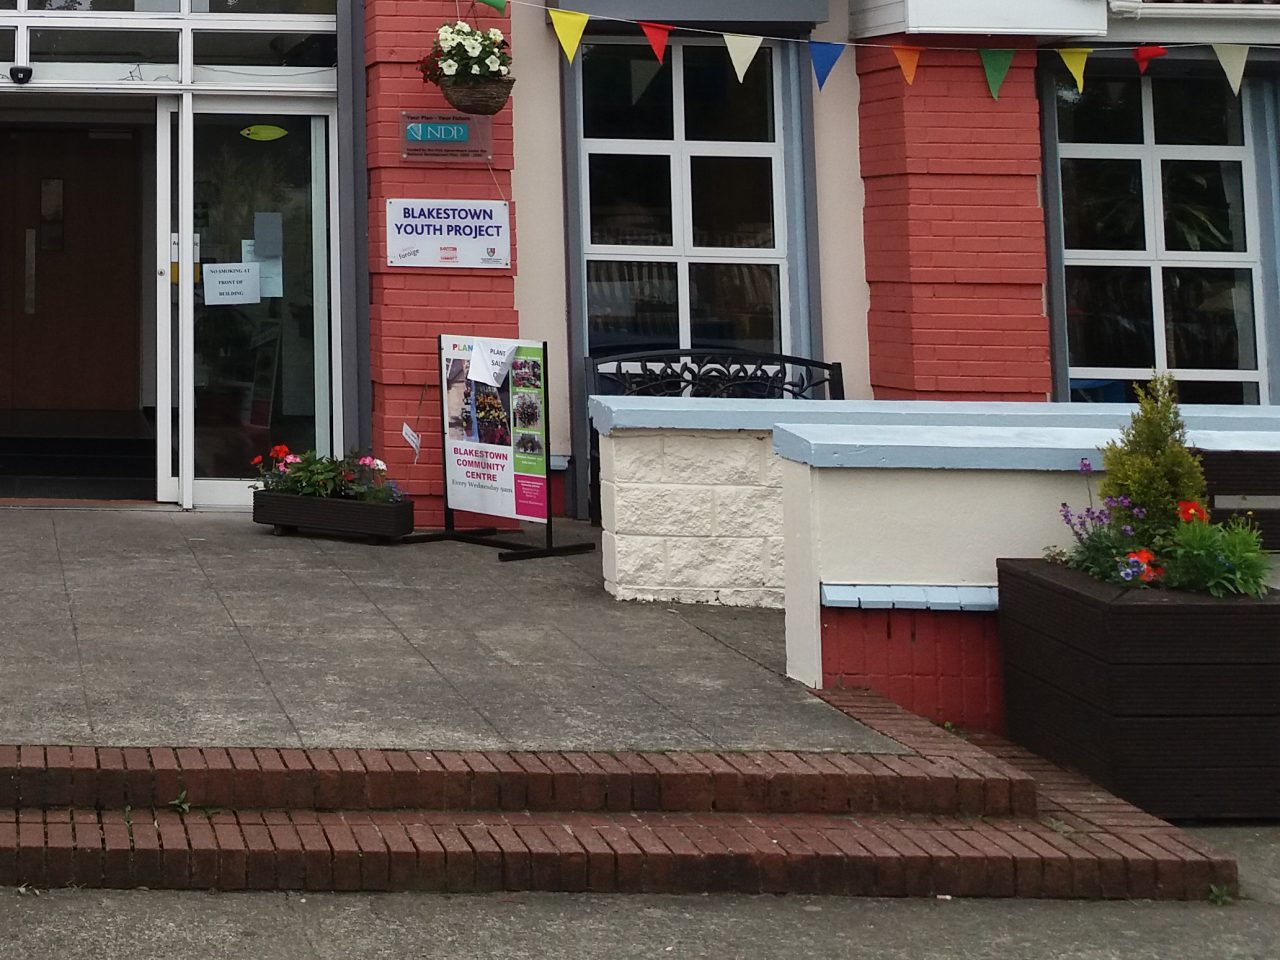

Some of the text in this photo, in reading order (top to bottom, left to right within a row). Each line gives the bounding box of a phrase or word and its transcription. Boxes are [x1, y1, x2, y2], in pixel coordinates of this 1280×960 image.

[427, 125, 464, 139] NDP
[403, 207, 493, 220] BLAKESTOWN
[395, 224, 502, 239] YOUTH PROJECT
[489, 348, 506, 357] PLANT
[453, 447, 508, 461] BLAKESTOWN
[456, 458, 506, 472] COMMUNITY
[465, 471, 498, 482] CENTRE
[451, 479, 467, 489] Every
[468, 481, 499, 493] Wednesday
